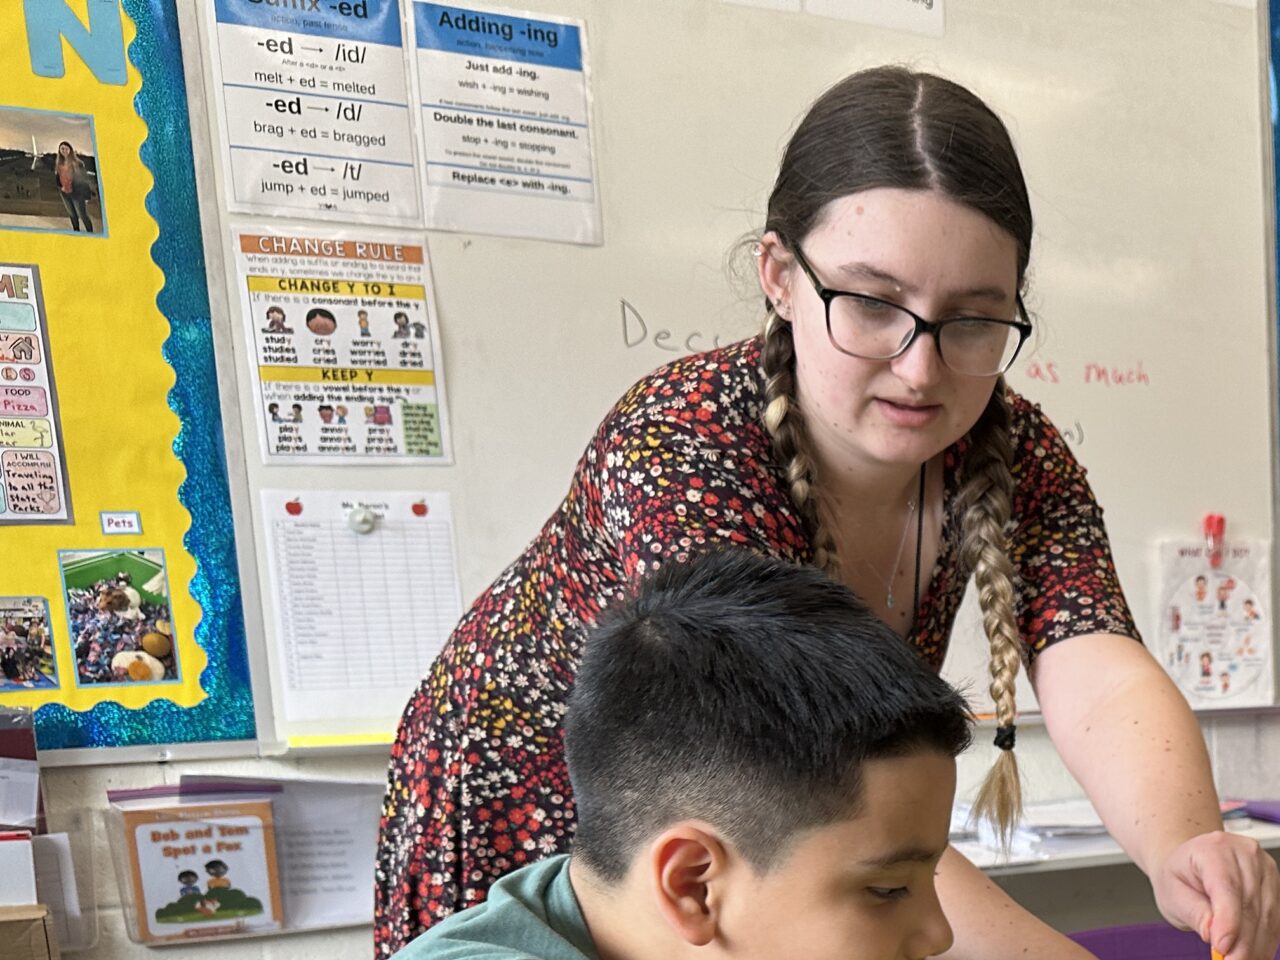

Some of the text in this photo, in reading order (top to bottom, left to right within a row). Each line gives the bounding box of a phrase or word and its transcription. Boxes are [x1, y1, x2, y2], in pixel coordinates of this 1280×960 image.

[439, 11, 559, 48] Adding -ing
[257, 37, 367, 64] -ed /id/
[465, 60, 489, 73] Just
[492, 65, 513, 76] add
[254, 70, 283, 85] melt
[299, 76, 316, 88] ed
[332, 80, 376, 96] melted
[458, 79, 479, 90] wish
[516, 86, 550, 101] wishing
[265, 97, 363, 122] -ed /d/
[433, 112, 474, 126] Double
[476, 116, 494, 128] the
[497, 121, 517, 132] last
[253, 120, 284, 138] brag
[300, 127, 317, 139] ed
[333, 129, 386, 147] bragged
[462, 134, 481, 146] stop
[519, 140, 556, 155] stopping
[272, 157, 362, 181] -ed /t/
[260, 178, 294, 196] jump
[310, 184, 327, 196] ed
[342, 186, 391, 203] jumped
[452, 171, 497, 186] Replace
[522, 180, 545, 191] with
[259, 235, 405, 261] CHANGE RULE
[278, 279, 341, 294] CHANGE
[348, 283, 357, 295] Y
[363, 284, 382, 296] TO
[361, 298, 394, 309] before
[321, 369, 374, 382] KEEP Y
[1026, 358, 1151, 386] as much
[5, 388, 31, 396] FOOD
[352, 385, 384, 395] before
[3, 400, 37, 412] Pizza
[20, 453, 41, 461] WILL
[6, 469, 54, 484] Traveling
[21, 482, 34, 491] all
[107, 517, 134, 529] Pets
